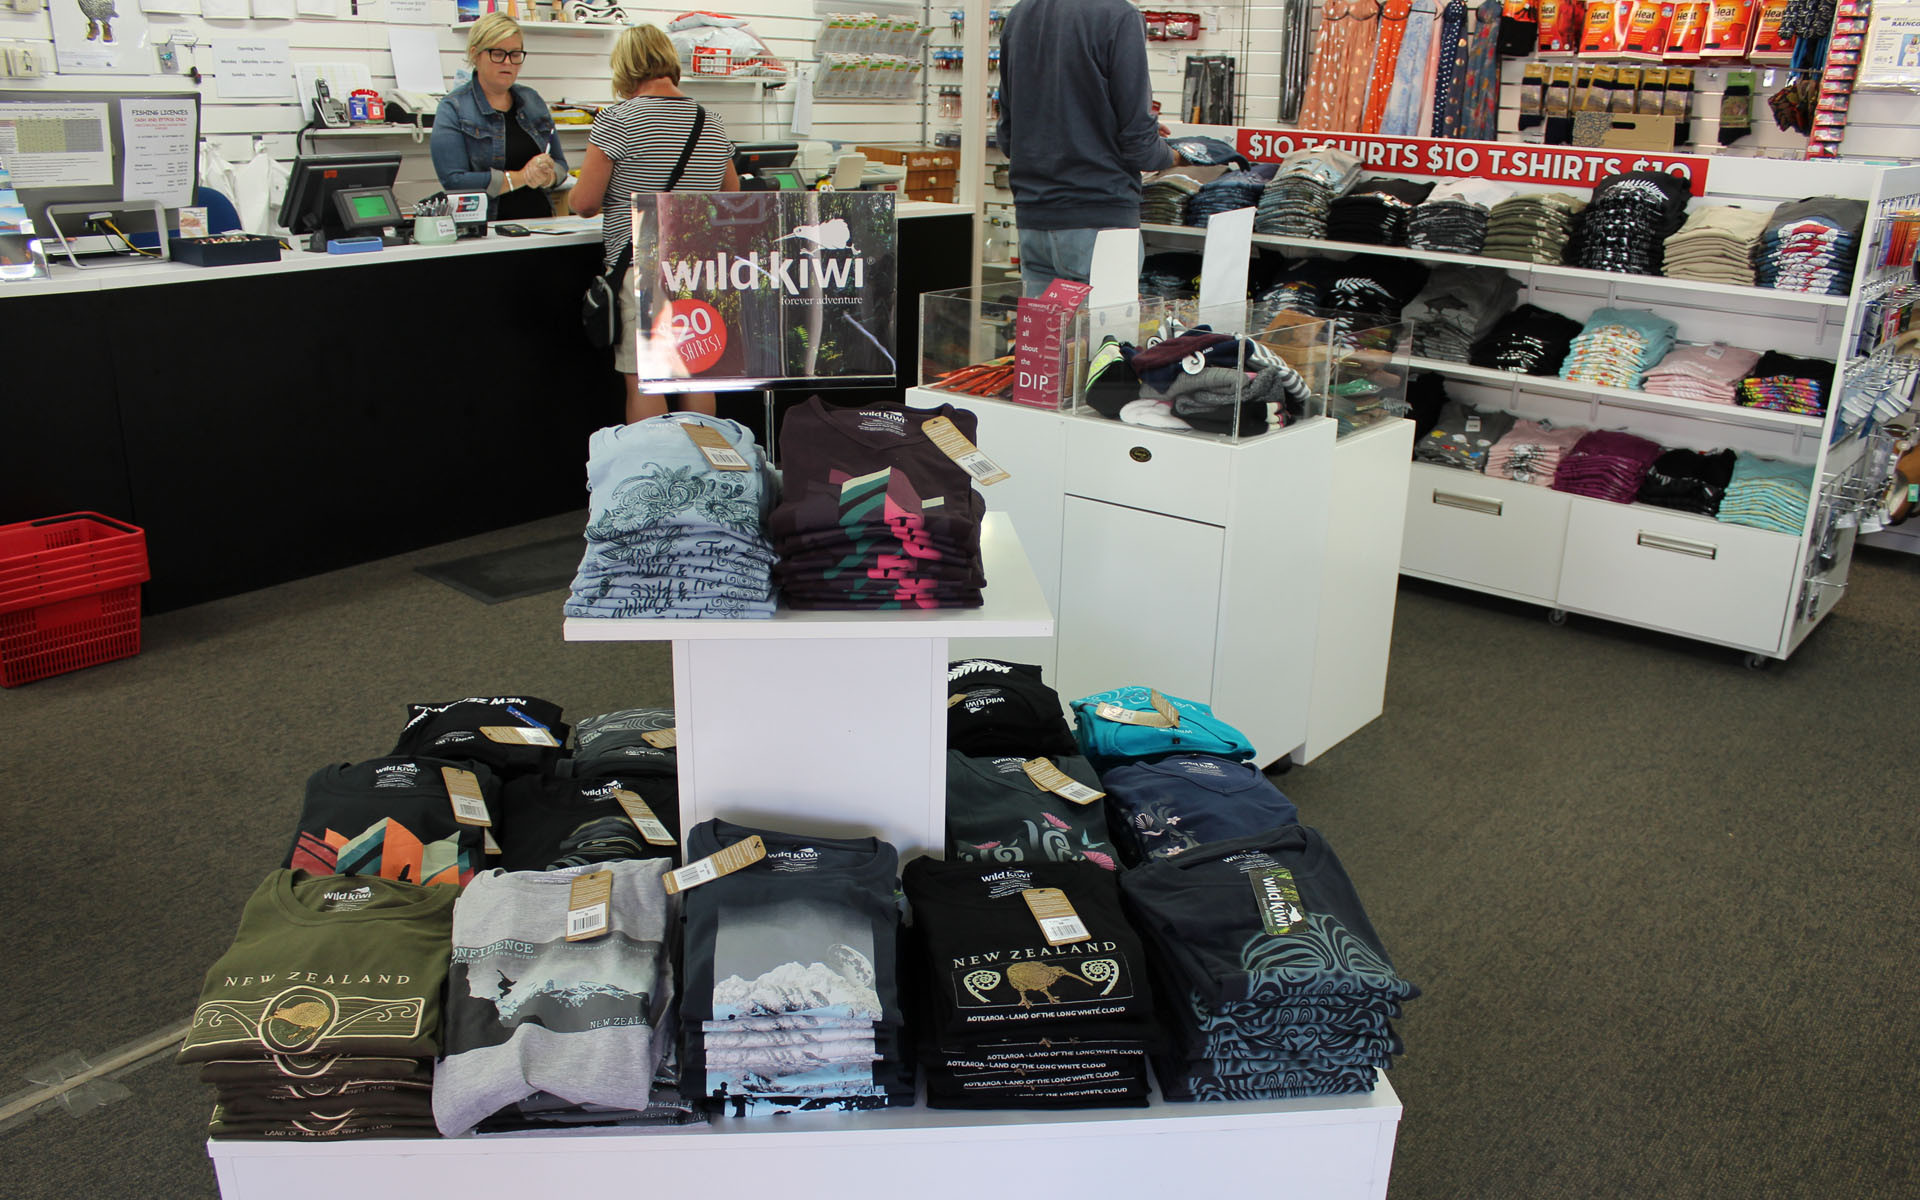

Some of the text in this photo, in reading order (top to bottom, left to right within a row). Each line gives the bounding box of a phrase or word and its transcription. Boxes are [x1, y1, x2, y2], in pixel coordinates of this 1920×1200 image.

[1591, 11, 1610, 20] Heat
[1635, 10, 1656, 20] Heat
[1715, 7, 1736, 16] Heat
[1249, 132, 1294, 159] $10
[1426, 143, 1480, 173] $10
[1488, 149, 1622, 182] T.SHIRTS
[661, 251, 864, 295] wild kiwi
[780, 294, 863, 306] forever adventure
[1022, 329, 1030, 337] all
[680, 333, 722, 362] SHIRTS!
[1021, 344, 1038, 353] about
[1020, 357, 1031, 366] the
[1019, 371, 1049, 391] DIP
[883, 412, 905, 423] kiwi
[376, 766, 395, 774] wild
[981, 871, 1005, 882] wild
[1262, 876, 1284, 900] wild
[324, 892, 371, 900] wild kiwi
[1269, 902, 1290, 927] kiwi
[953, 941, 1117, 969] NEW ZEALAND
[224, 971, 411, 987] NEW ZEALAND
[967, 1013, 1004, 1022] AOTEAROA
[1009, 1012, 1029, 1020] LAND
[1076, 1008, 1100, 1016] WHITE
[1101, 1006, 1126, 1014] CLOUD
[590, 1018, 610, 1029] NEW
[946, 1060, 985, 1068] AOTEAROA
[963, 1080, 1001, 1088] AOTEAROA
[1071, 1073, 1095, 1082] WHITE
[1095, 1070, 1120, 1079] CLOUD
